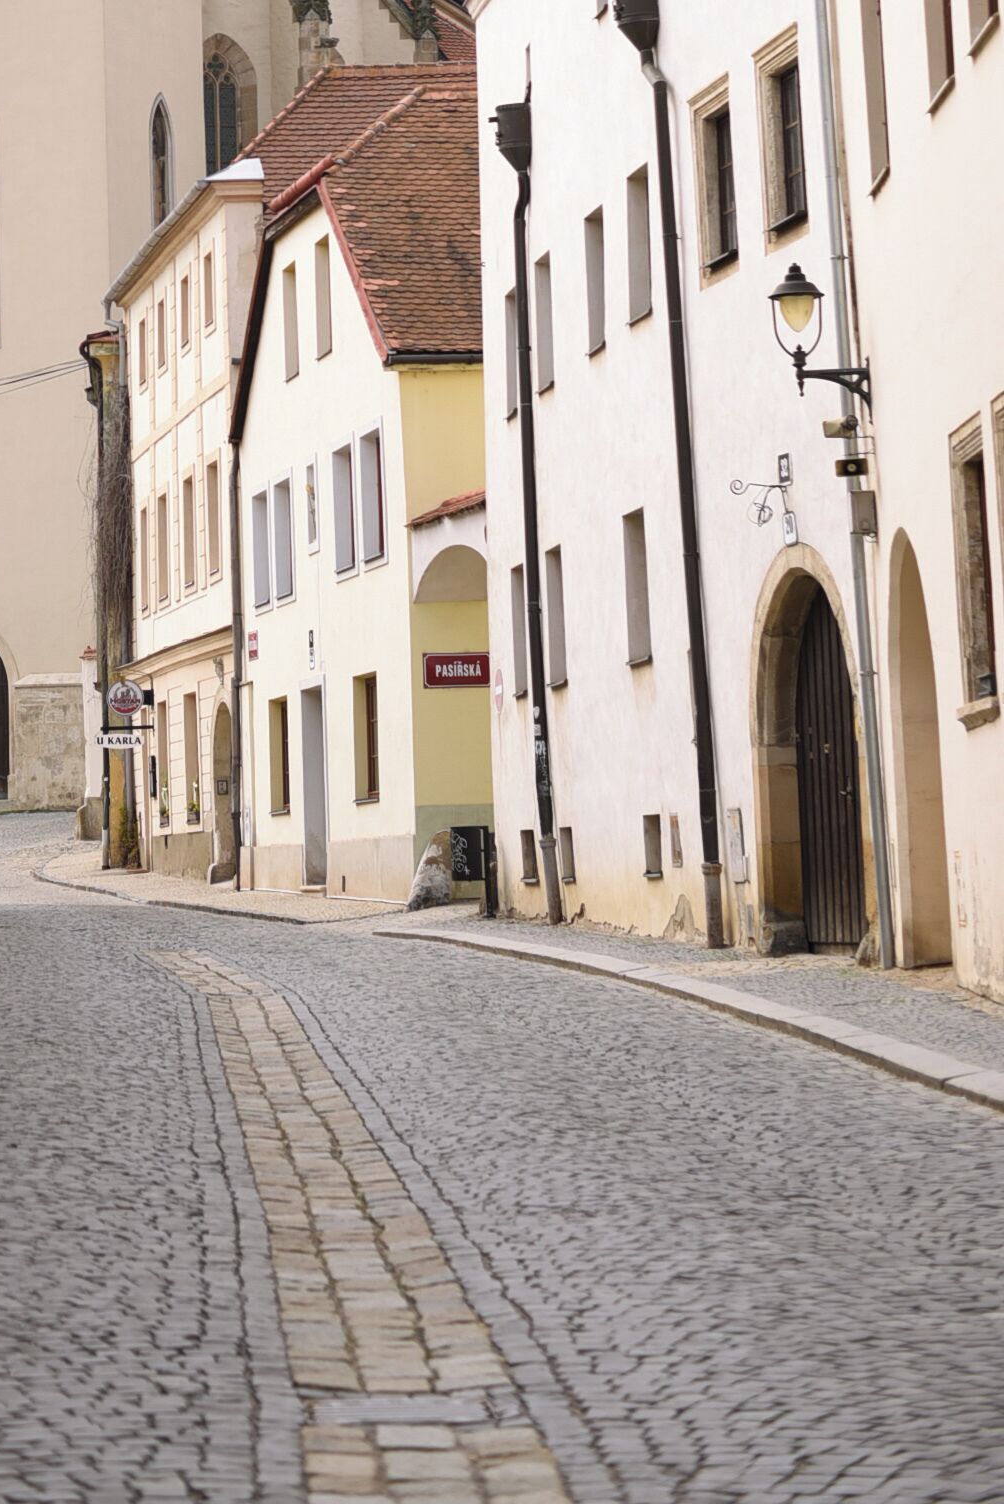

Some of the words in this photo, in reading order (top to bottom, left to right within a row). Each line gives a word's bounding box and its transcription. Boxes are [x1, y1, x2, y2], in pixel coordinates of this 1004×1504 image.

[435, 660, 482, 678] PASÍŘSKÁ
[96, 736, 104, 745] U
[107, 736, 142, 745] KARLA
